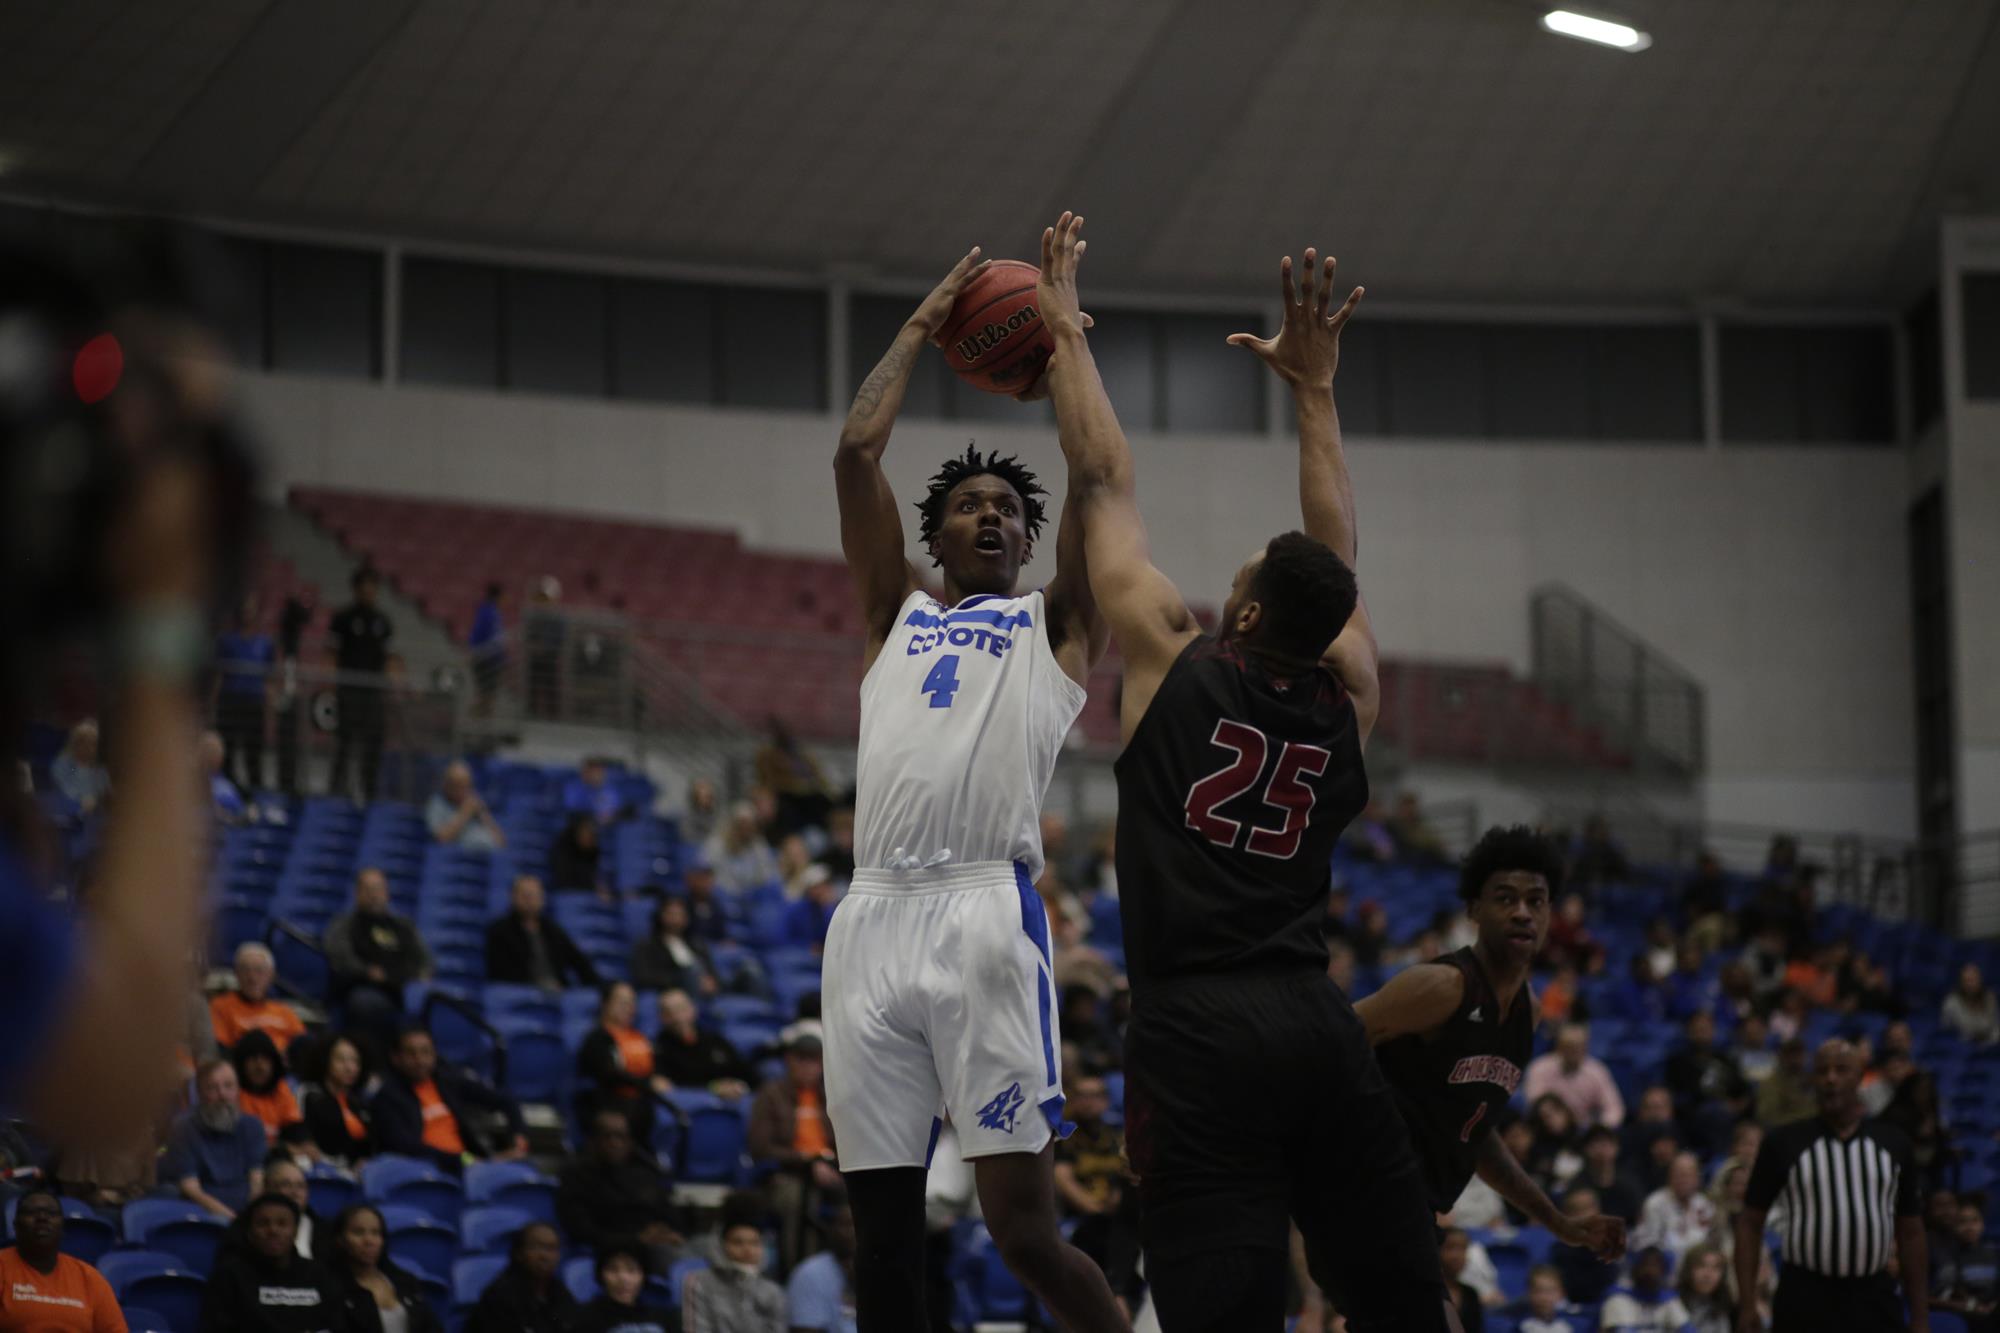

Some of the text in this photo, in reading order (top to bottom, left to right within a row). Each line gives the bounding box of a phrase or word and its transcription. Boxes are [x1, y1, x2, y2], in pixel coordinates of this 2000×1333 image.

[956, 304, 1040, 363] Wilson
[921, 654, 960, 708] 4
[1184, 718, 1331, 860] 25
[1459, 1101, 1488, 1143] 1
